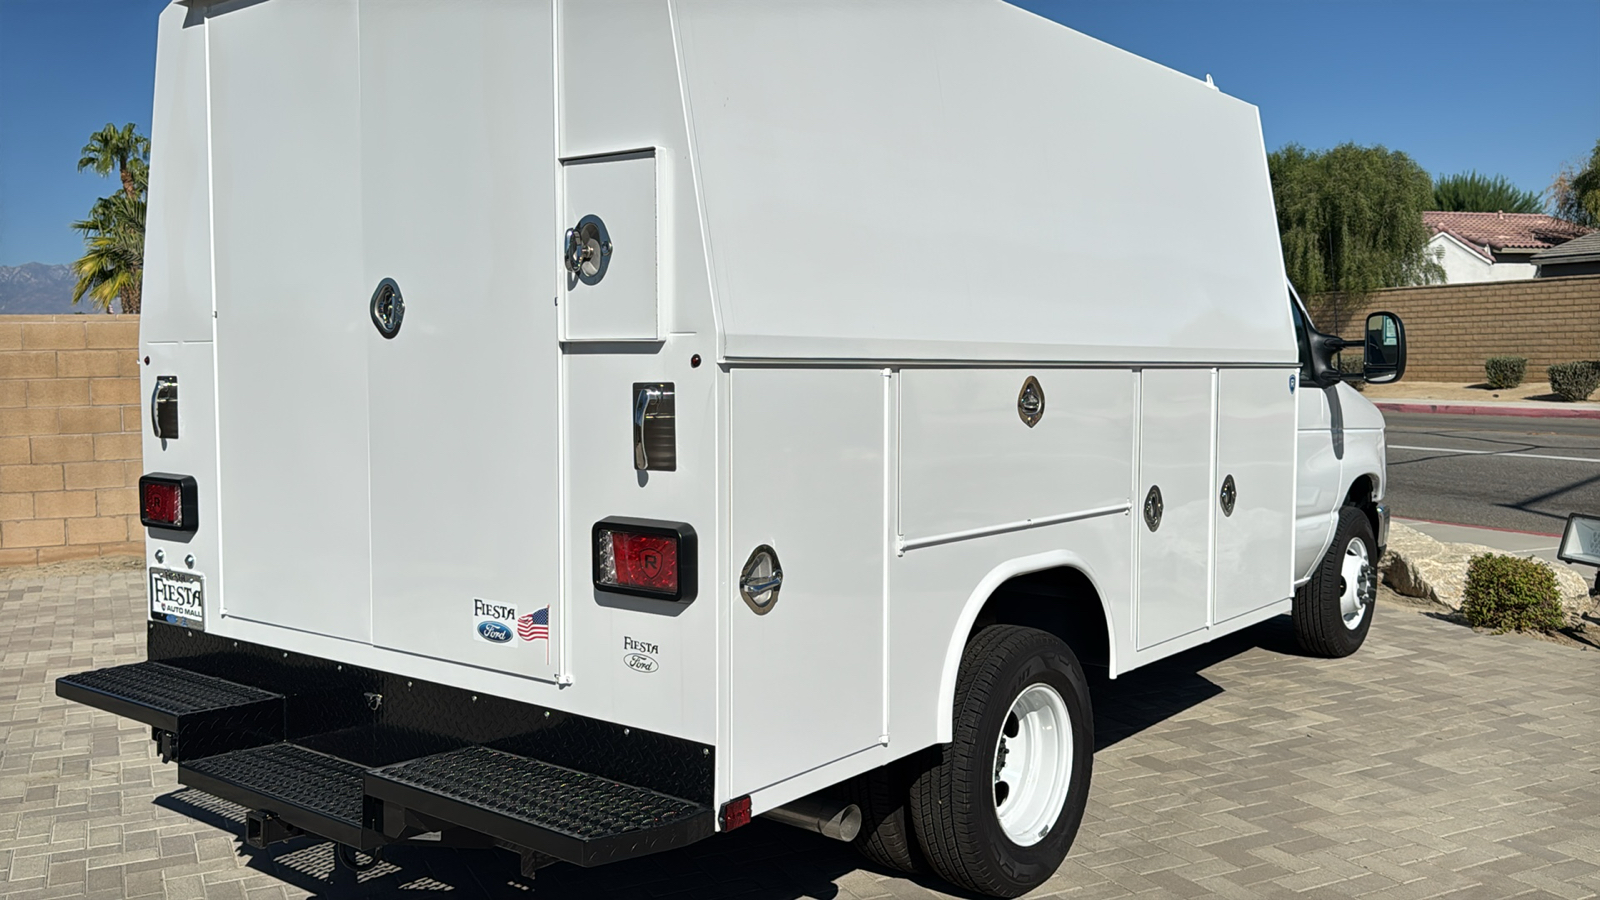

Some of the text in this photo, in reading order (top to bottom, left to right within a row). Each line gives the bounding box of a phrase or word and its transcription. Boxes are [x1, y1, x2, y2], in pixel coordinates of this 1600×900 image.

[154, 497, 161, 507] R
[644, 554, 657, 569] R
[154, 577, 202, 608] FIESTA
[167, 605, 202, 617] AUTO MALL
[474, 598, 515, 620] FIESTA
[483, 623, 506, 640] Ford
[624, 636, 659, 654] FIESTA
[629, 655, 653, 671] Ford
